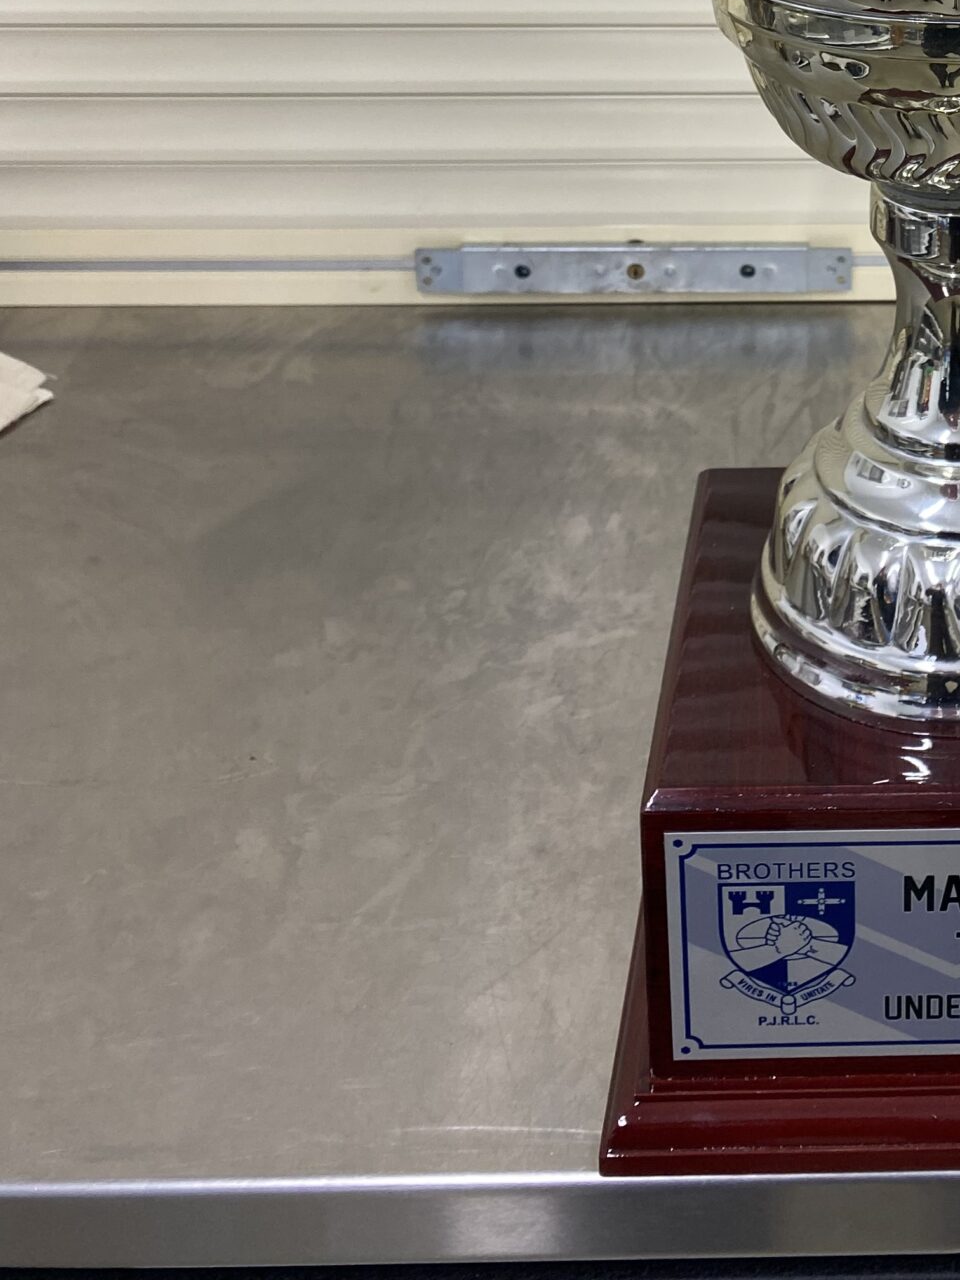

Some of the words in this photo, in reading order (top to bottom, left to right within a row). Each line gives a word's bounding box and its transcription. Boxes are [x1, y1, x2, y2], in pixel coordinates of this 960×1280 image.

[717, 862, 855, 880] BROTHERS
[737, 978, 764, 997] VIRES
[765, 993, 778, 1003] IN
